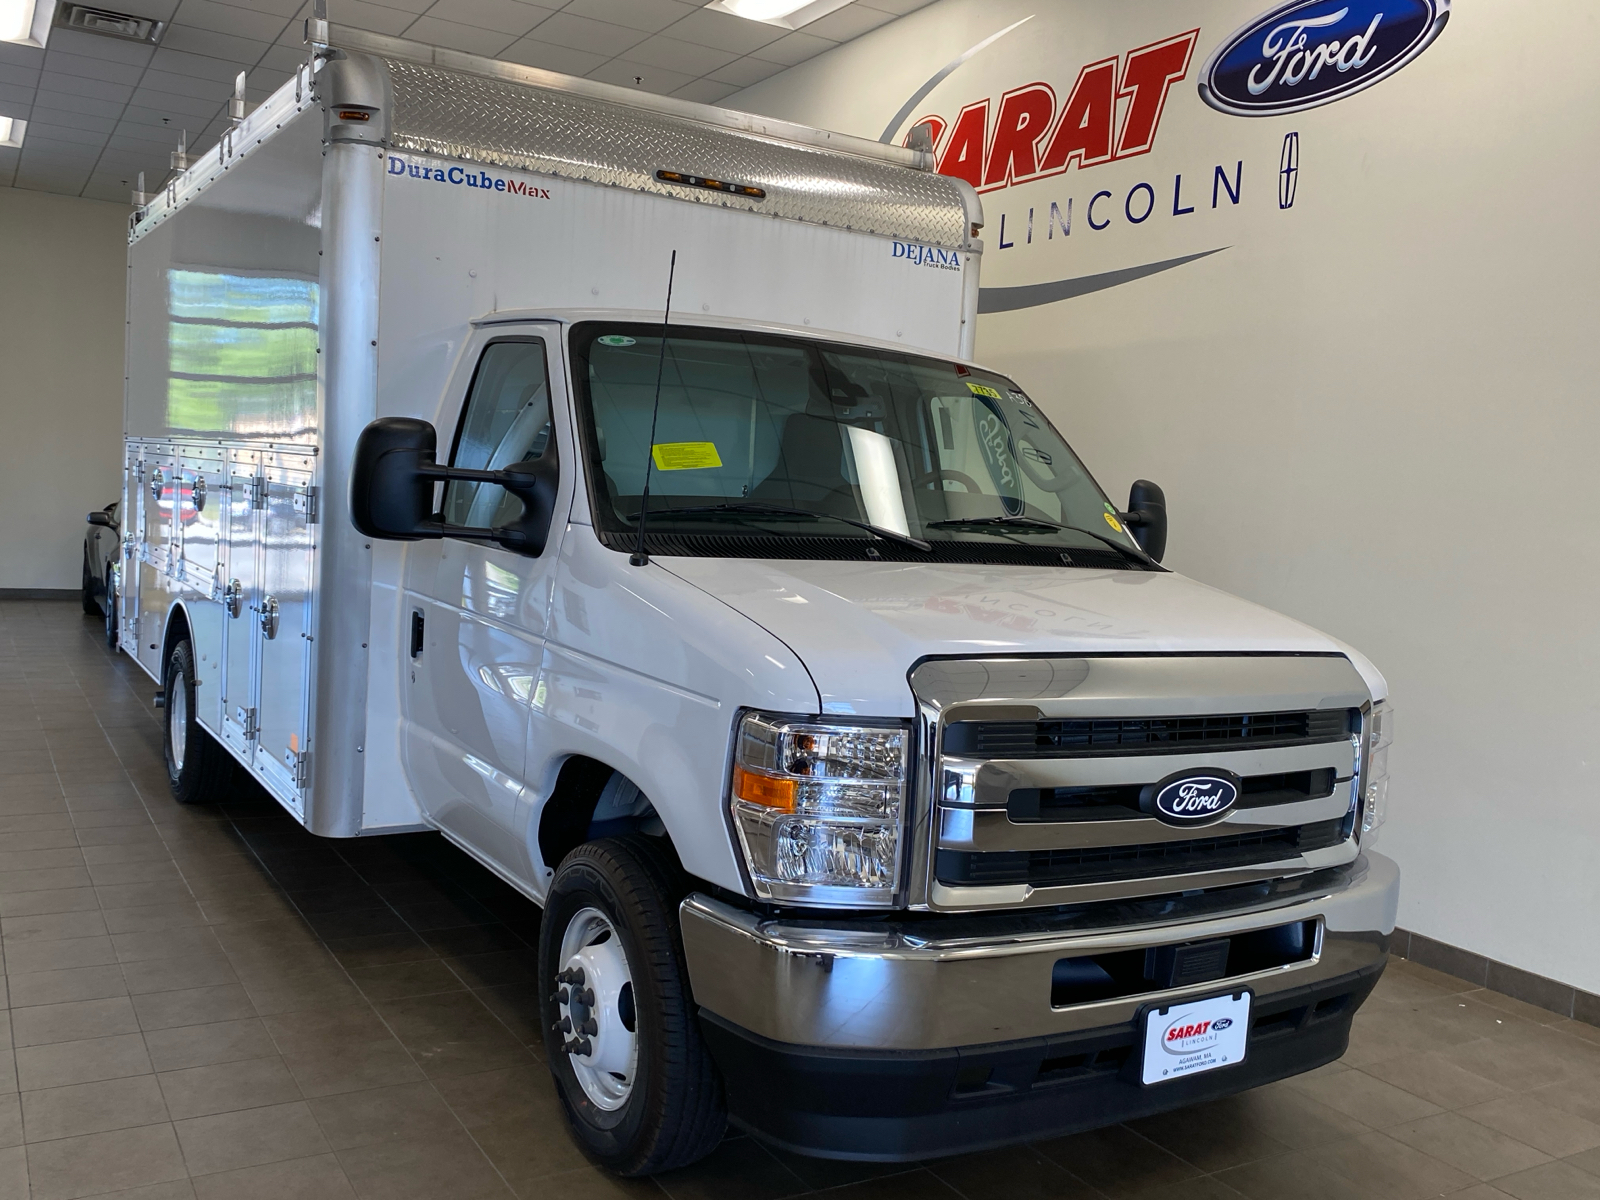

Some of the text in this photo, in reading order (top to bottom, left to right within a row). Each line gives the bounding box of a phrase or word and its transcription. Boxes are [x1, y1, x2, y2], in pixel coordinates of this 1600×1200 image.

[1247, 6, 1384, 95] Ford
[999, 161, 1243, 250] LINCOLN
[891, 241, 961, 266] DEJANA
[922, 261, 961, 272] Truck Bodies
[1172, 783, 1223, 812] Ford
[1166, 1020, 1211, 1042] SARAT
[1185, 1035, 1213, 1046] LINCOLN
[1203, 1052, 1212, 1060] MA
